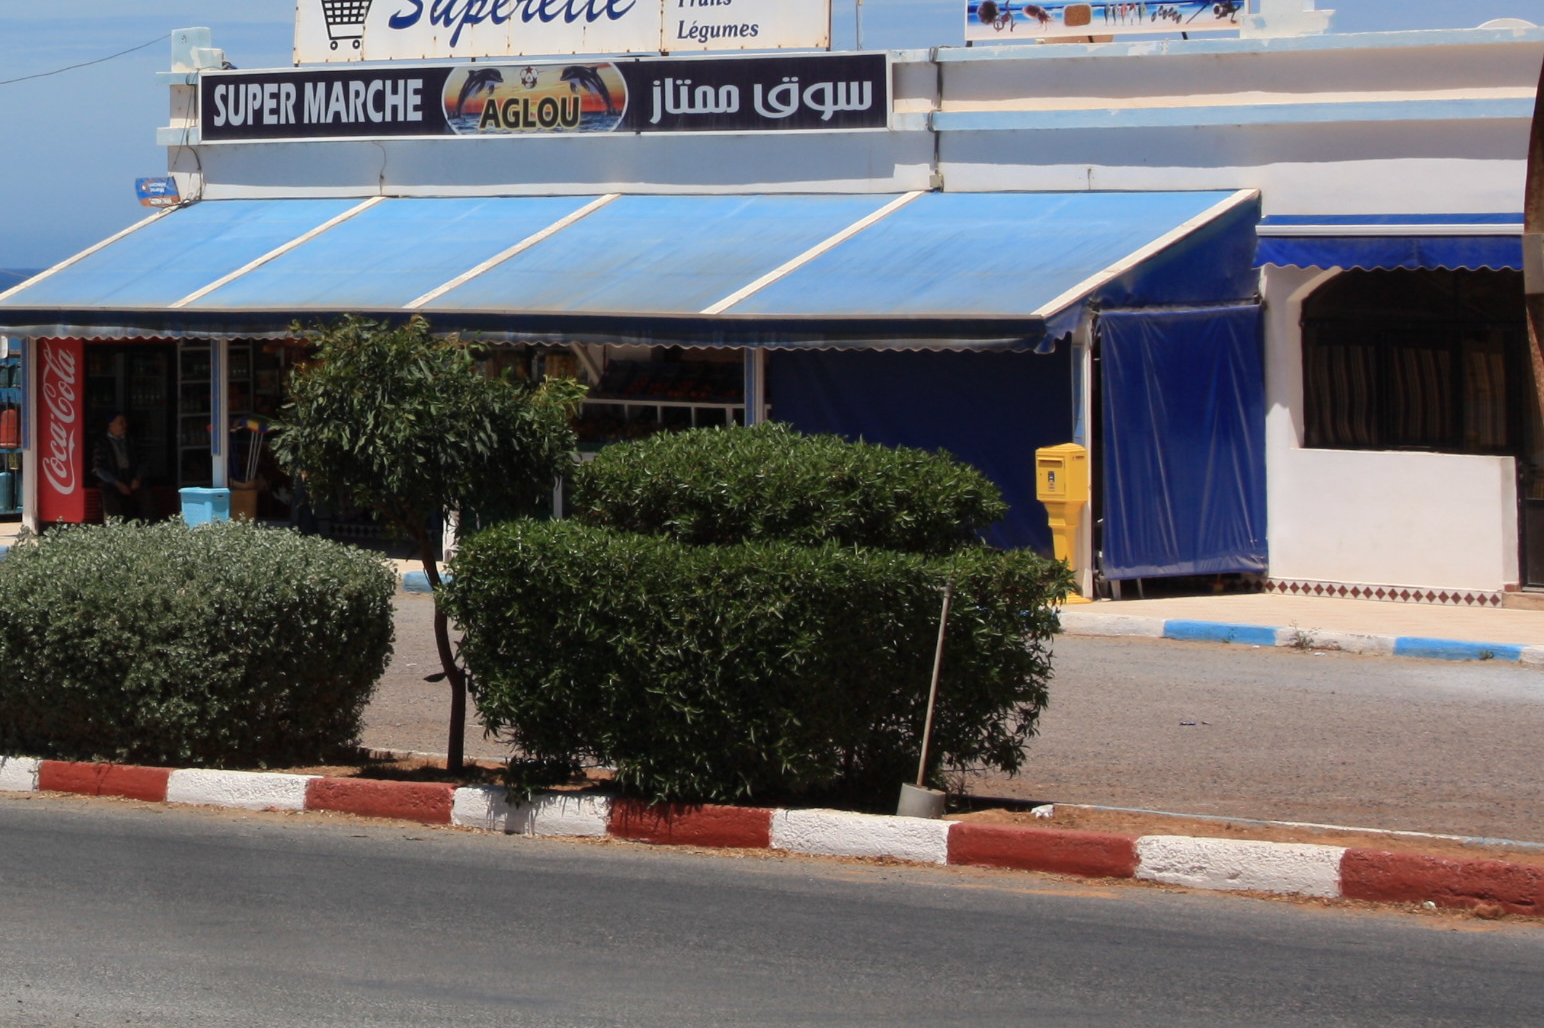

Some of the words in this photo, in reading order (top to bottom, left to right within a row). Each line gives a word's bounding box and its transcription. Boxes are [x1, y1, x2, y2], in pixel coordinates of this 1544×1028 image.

[676, 19, 759, 44] Légumes
[213, 84, 297, 128] SUPER
[303, 79, 424, 124] MARCHE
[479, 93, 581, 132] AGLOU
[649, 77, 740, 125] ممتاز
[753, 76, 872, 121] سوق
[42, 339, 76, 495] Coca-Cola
